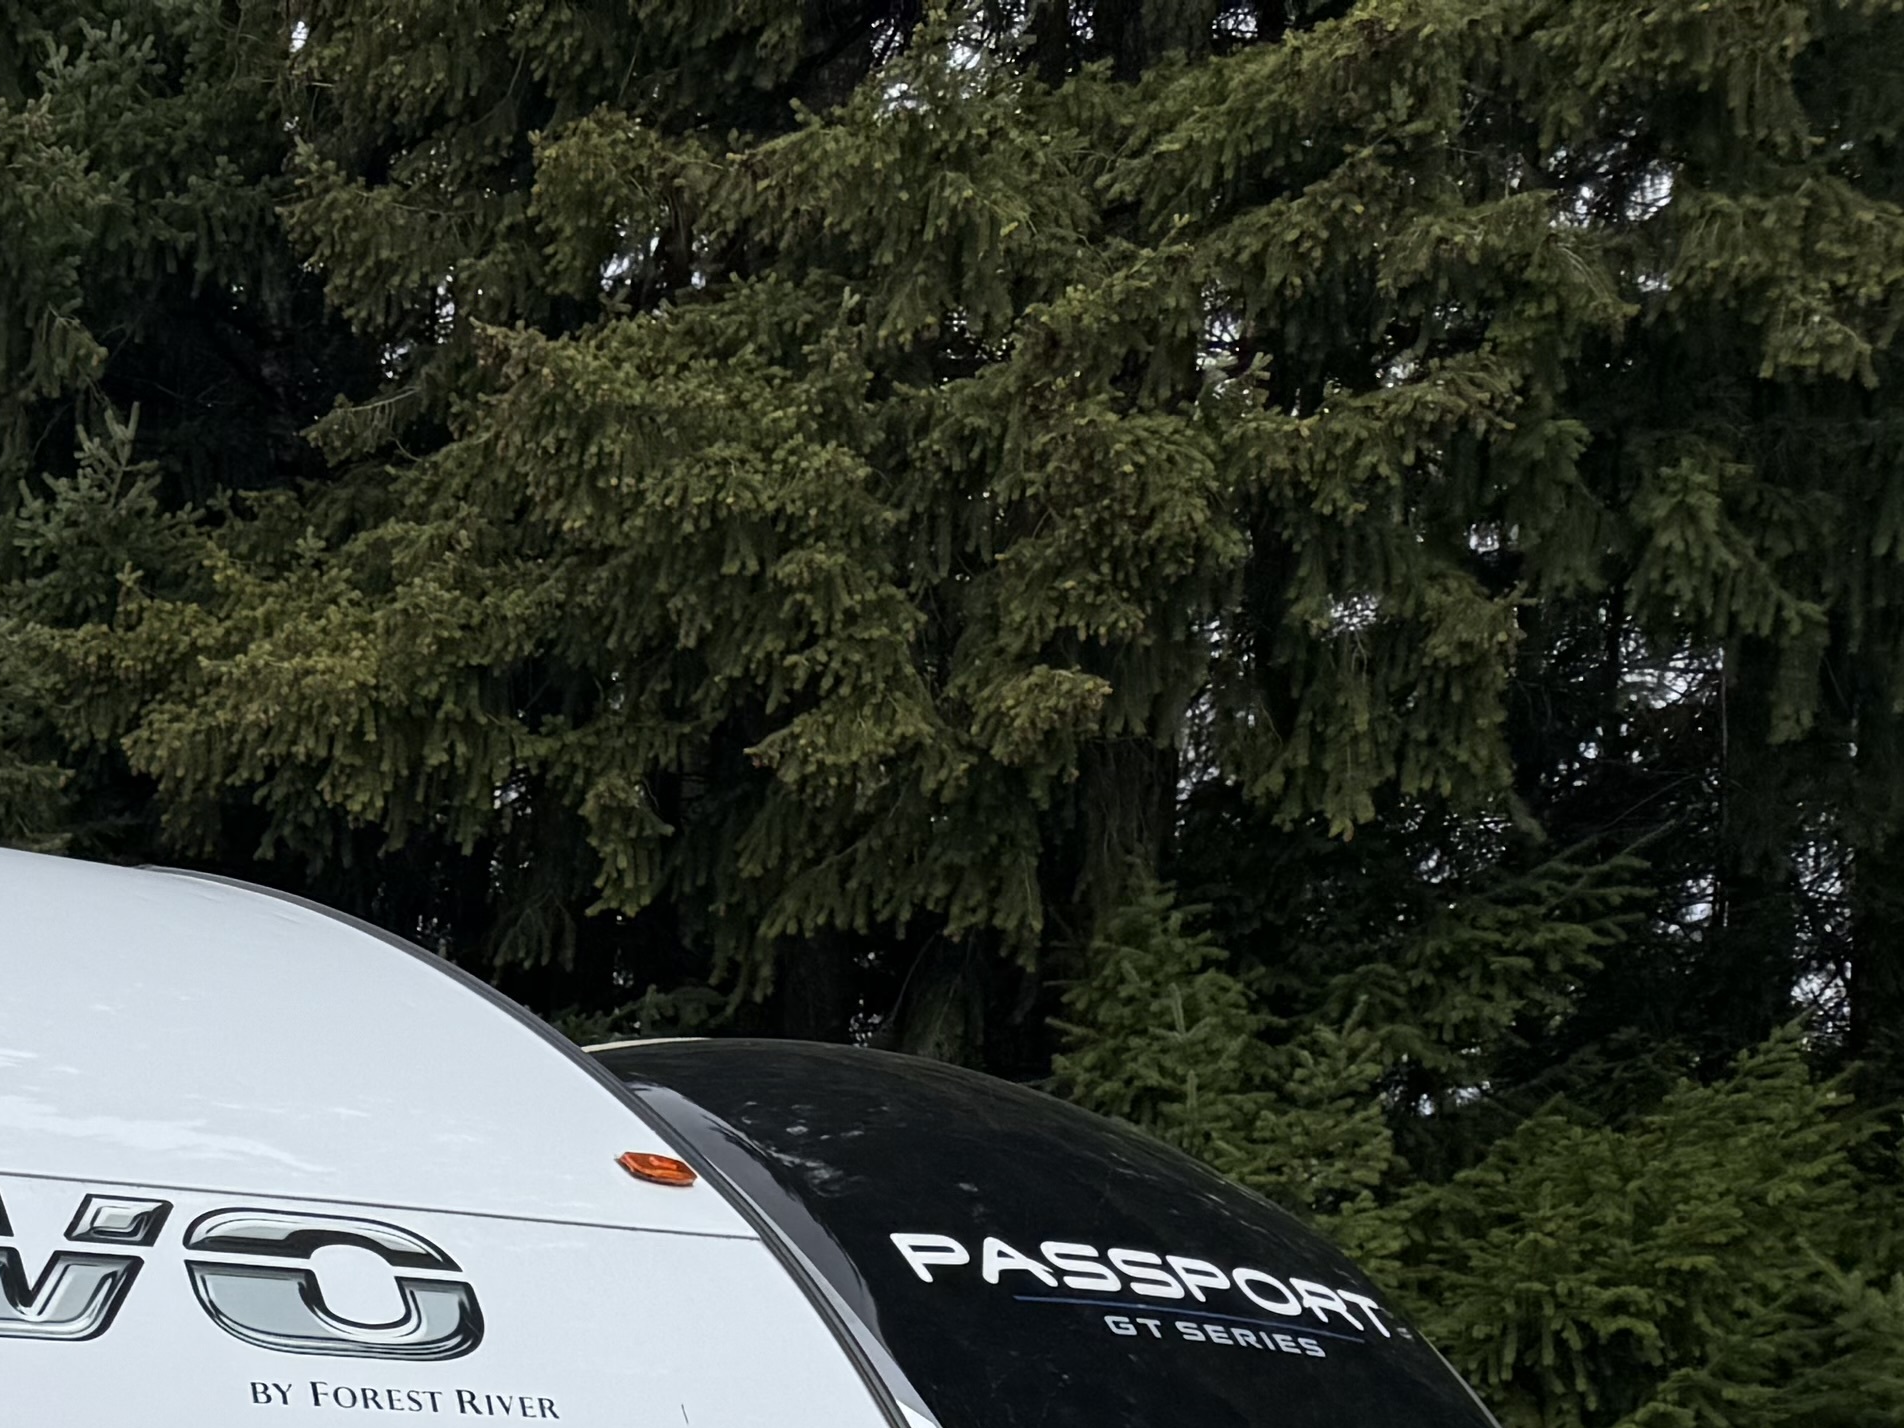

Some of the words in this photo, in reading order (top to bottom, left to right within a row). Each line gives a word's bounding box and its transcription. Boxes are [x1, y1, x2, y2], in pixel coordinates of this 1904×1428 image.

[889, 1233, 1391, 1337] PASSPORT
[1103, 1315, 1164, 1338] GT
[1175, 1320, 1326, 1358] SERIES
[249, 1381, 293, 1405] BY
[309, 1381, 443, 1412] FOREST
[455, 1389, 560, 1419] RIVER
